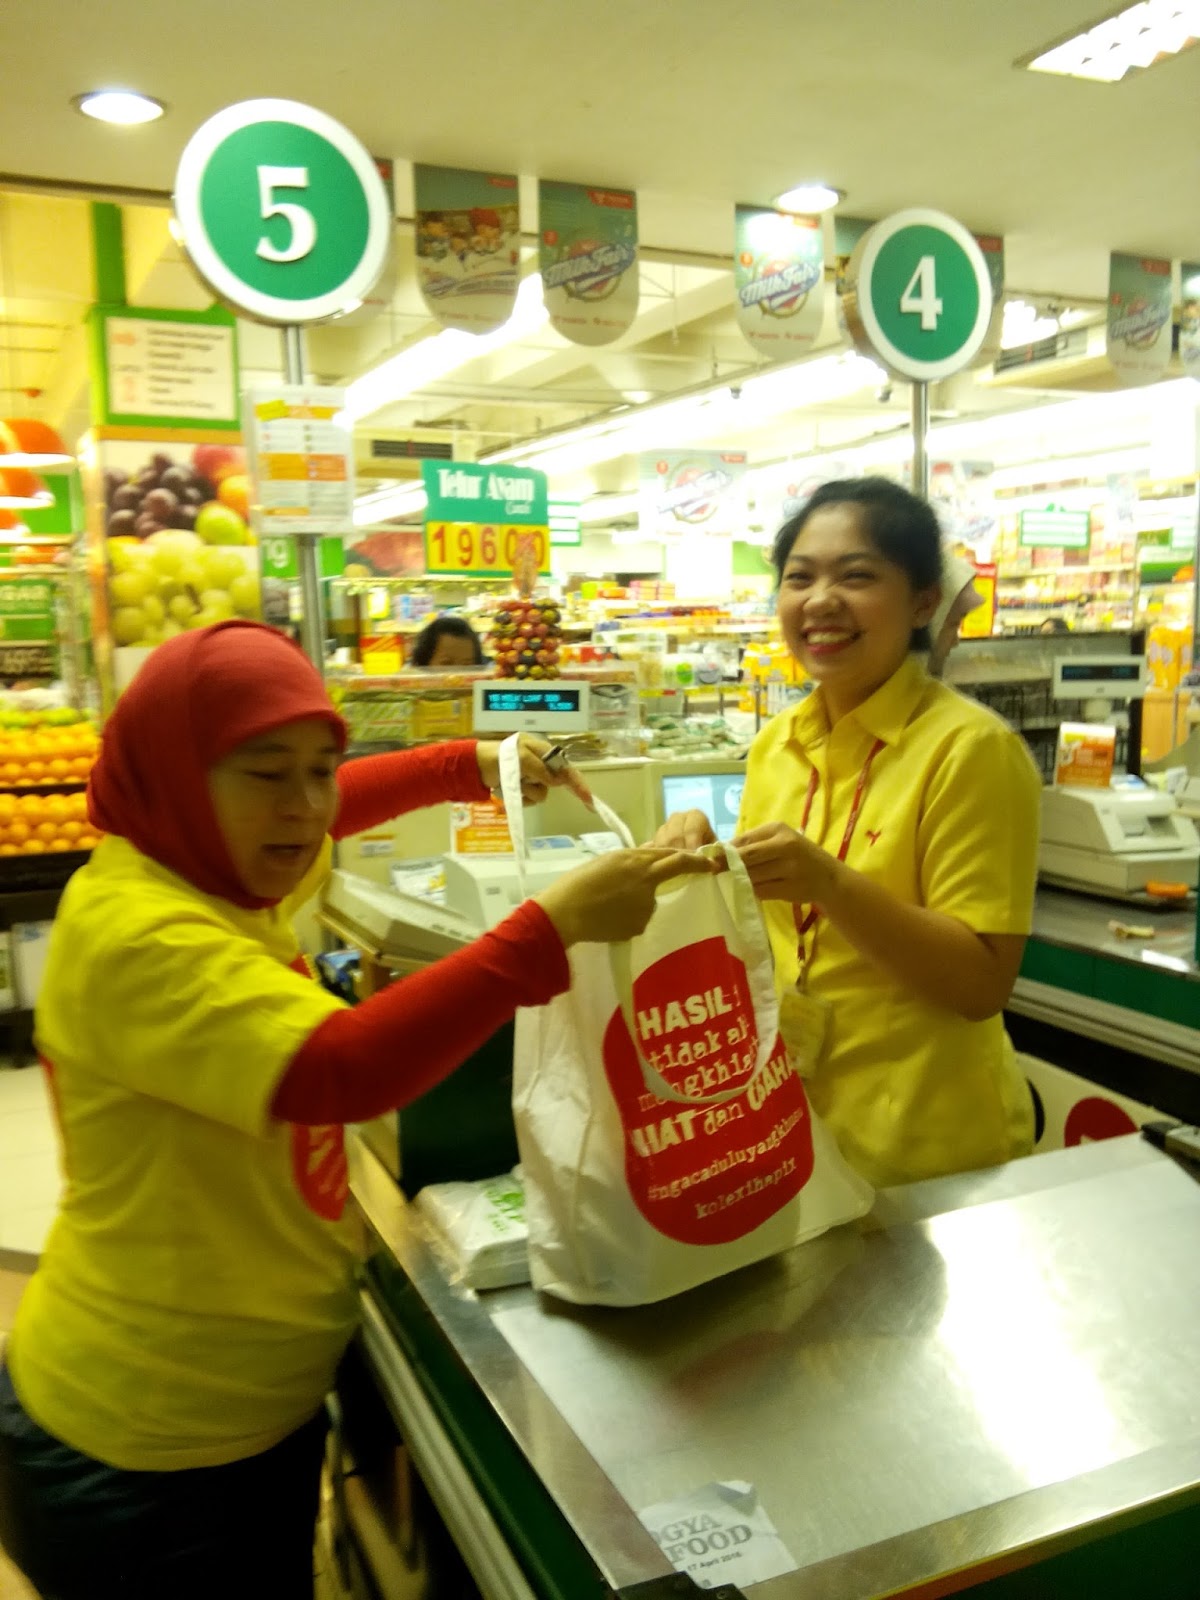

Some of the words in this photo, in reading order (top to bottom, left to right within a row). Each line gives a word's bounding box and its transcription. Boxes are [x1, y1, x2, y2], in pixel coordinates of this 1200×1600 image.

[255, 165, 316, 262] 5
[900, 255, 943, 331] 4
[437, 468, 482, 499] Telur
[485, 472, 535, 501] Ayam
[637, 985, 733, 1041] HASIL
[648, 1030, 722, 1073] tidak
[703, 1102, 745, 1136] dan
[664, 1525, 752, 1563] FOOD
